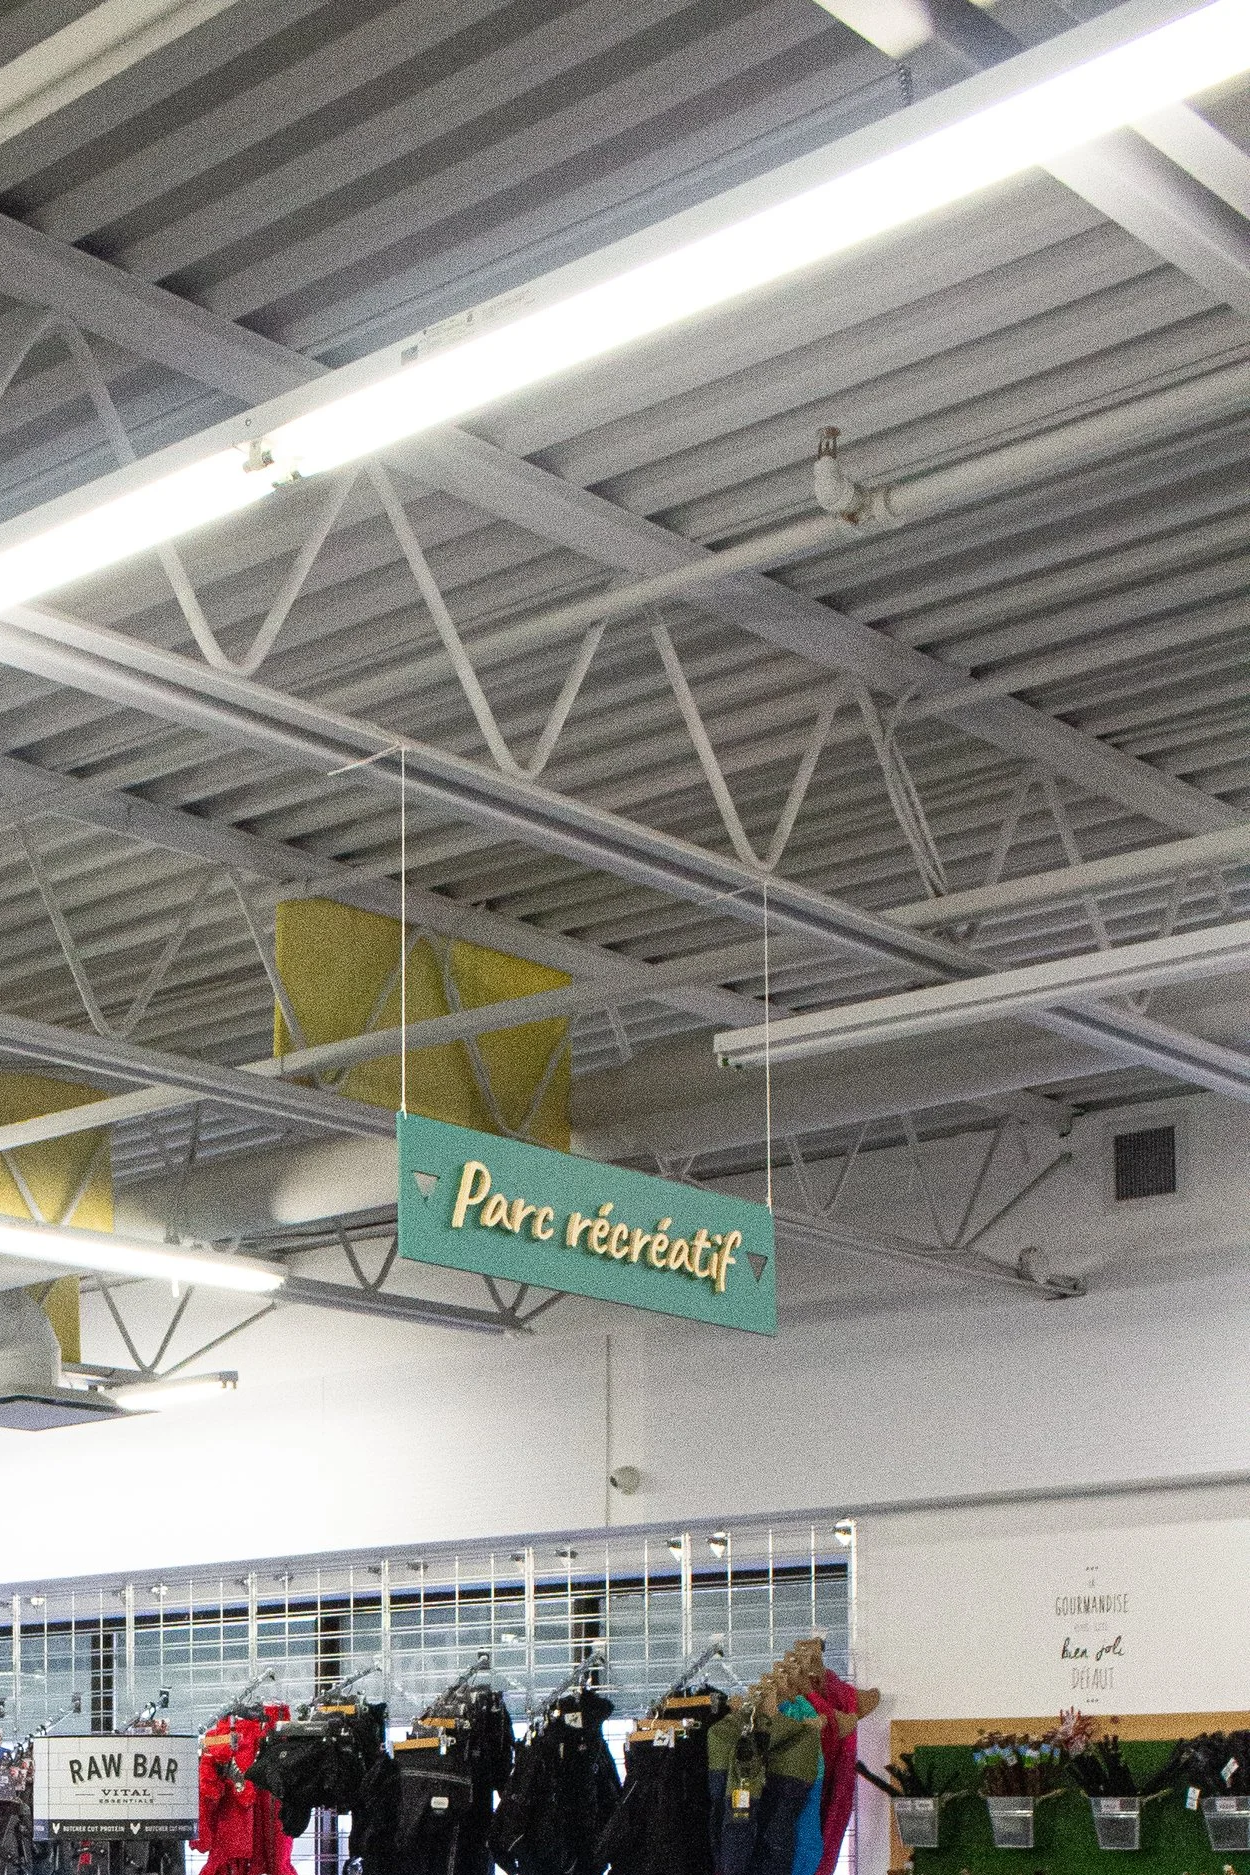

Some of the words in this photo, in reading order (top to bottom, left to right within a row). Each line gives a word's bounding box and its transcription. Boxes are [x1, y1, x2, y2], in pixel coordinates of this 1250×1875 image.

[451, 1160, 554, 1240] Parc
[566, 1202, 742, 1294] récréatif
[1055, 1593, 1129, 1616] GOURMANDISE
[69, 1753, 123, 1784] RAW
[133, 1753, 179, 1784] BAR
[101, 1788, 151, 1797] VITAL
